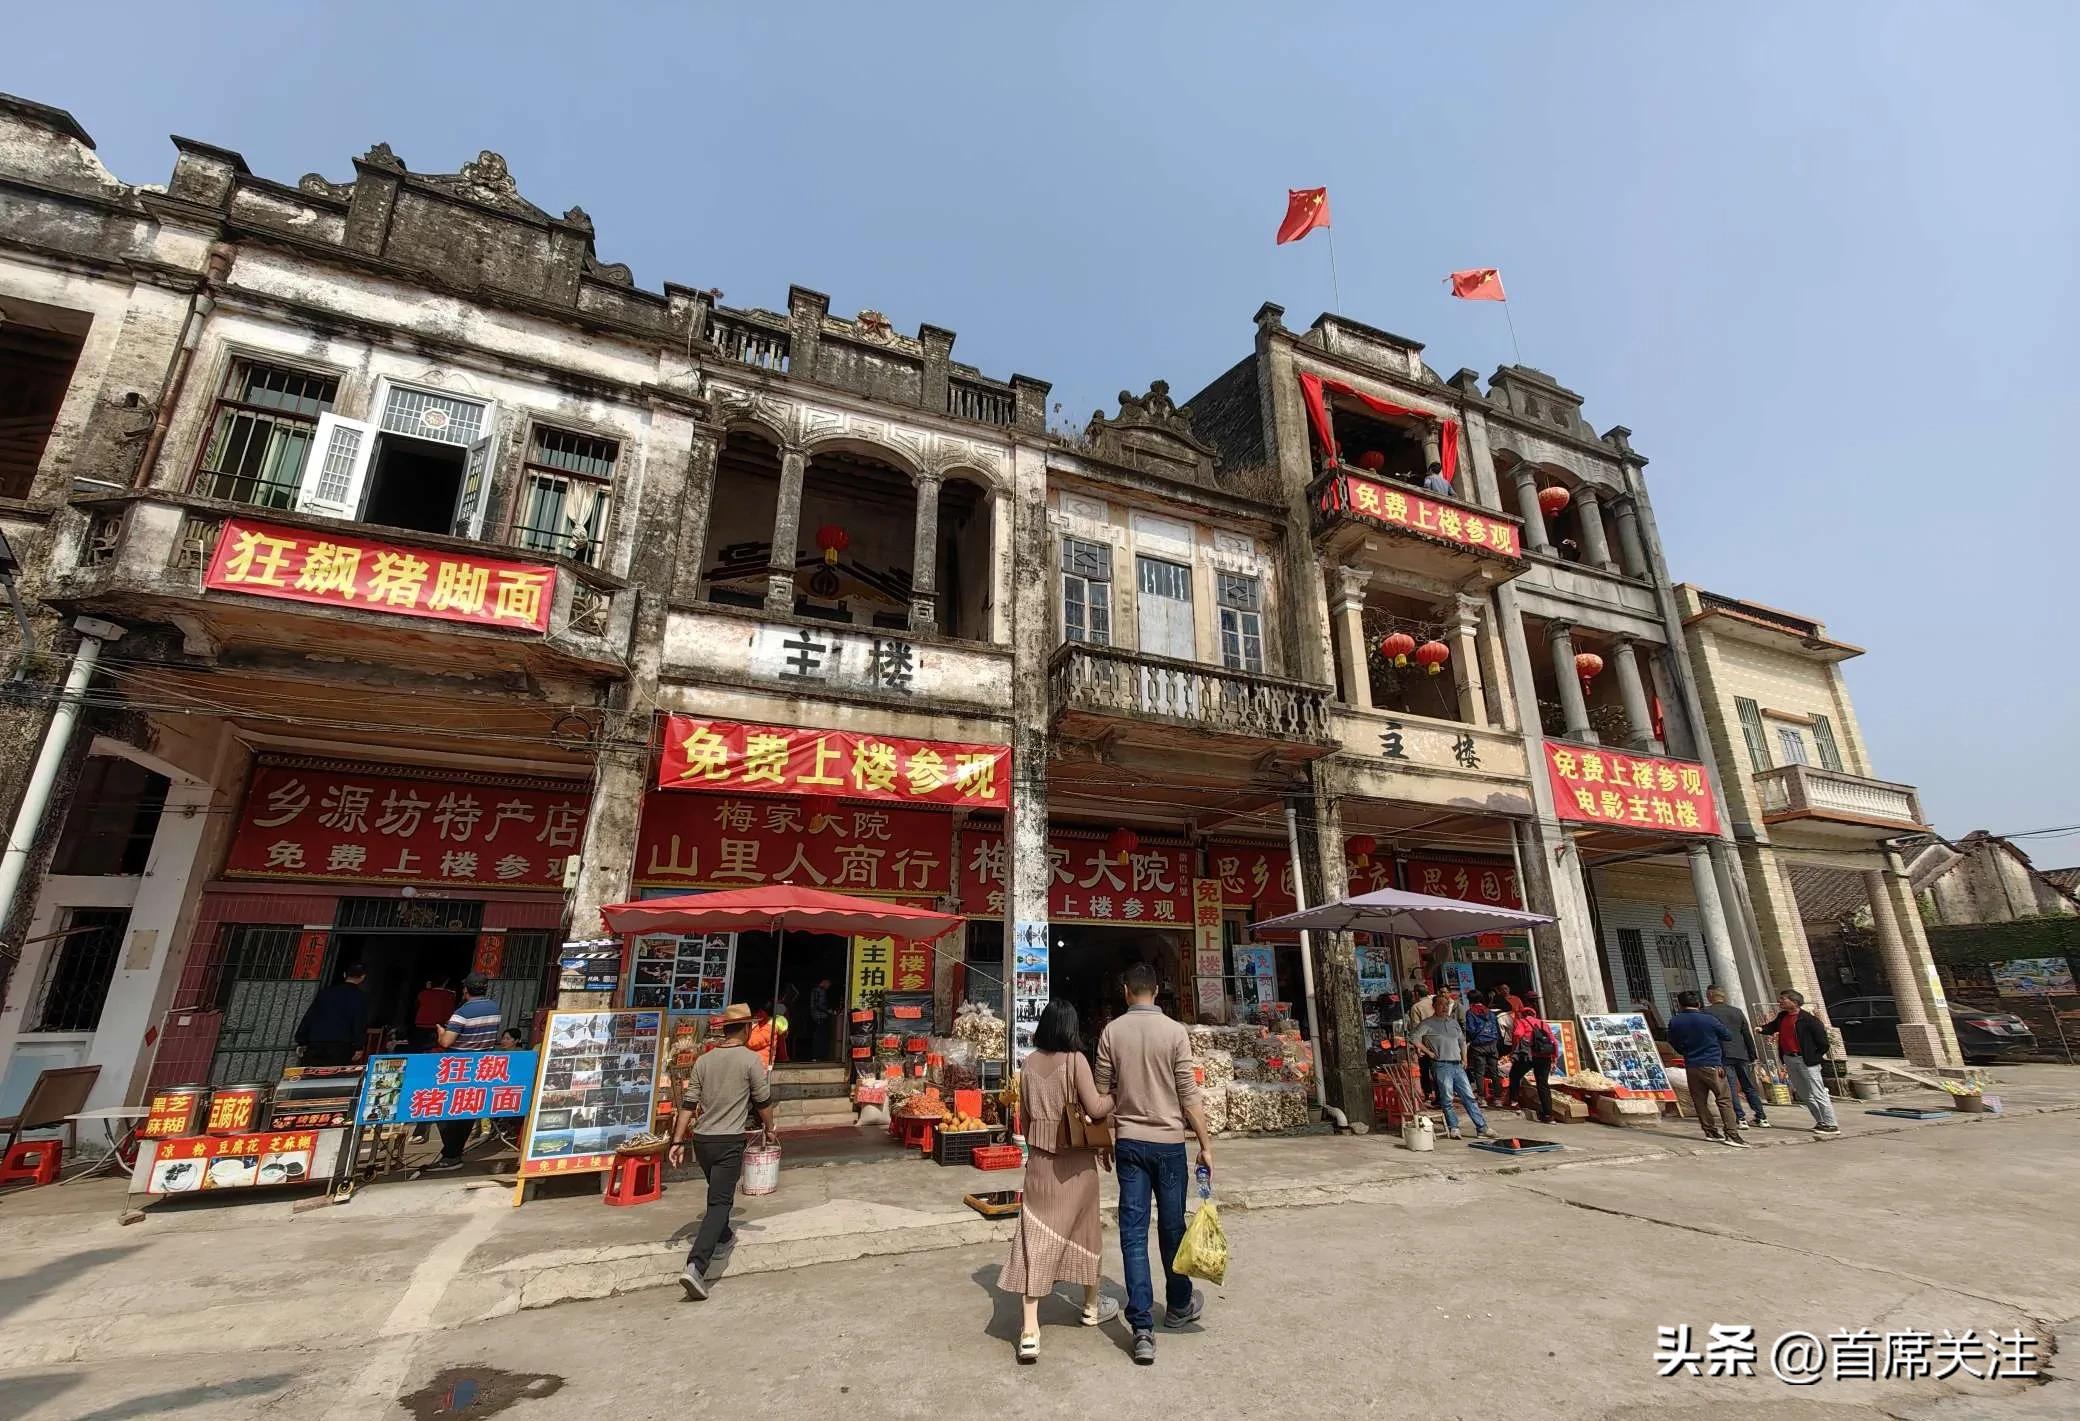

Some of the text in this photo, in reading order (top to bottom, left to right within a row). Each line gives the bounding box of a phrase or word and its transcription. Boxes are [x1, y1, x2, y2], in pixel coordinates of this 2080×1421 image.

[1356, 483, 1514, 553] 免费上楼参观
[223, 530, 547, 626] 狂飙猪脚面
[778, 630, 914, 697] 主楼
[680, 726, 996, 799] 免费上楼参观
[1378, 721, 1481, 770] 主楼
[1553, 750, 1705, 796] 免费上楼参观
[253, 778, 585, 848] 乡源坊特产店
[713, 799, 893, 841] 梅家大院
[1575, 787, 1701, 829] 电影主拍楼
[647, 833, 940, 889] 山里人商行
[985, 890, 1176, 920] 免上楼参观
[859, 936, 888, 1010] 主拍楼
[437, 1055, 510, 1085] 狂飙
[151, 1095, 193, 1113] 黑芝
[208, 1096, 253, 1129] 豆腐花
[410, 1085, 526, 1118] 猪脚面
[145, 1116, 187, 1134] 麻糊
[216, 1138, 261, 1155] 豆腐花
[268, 1135, 312, 1152] 芝麻糊
